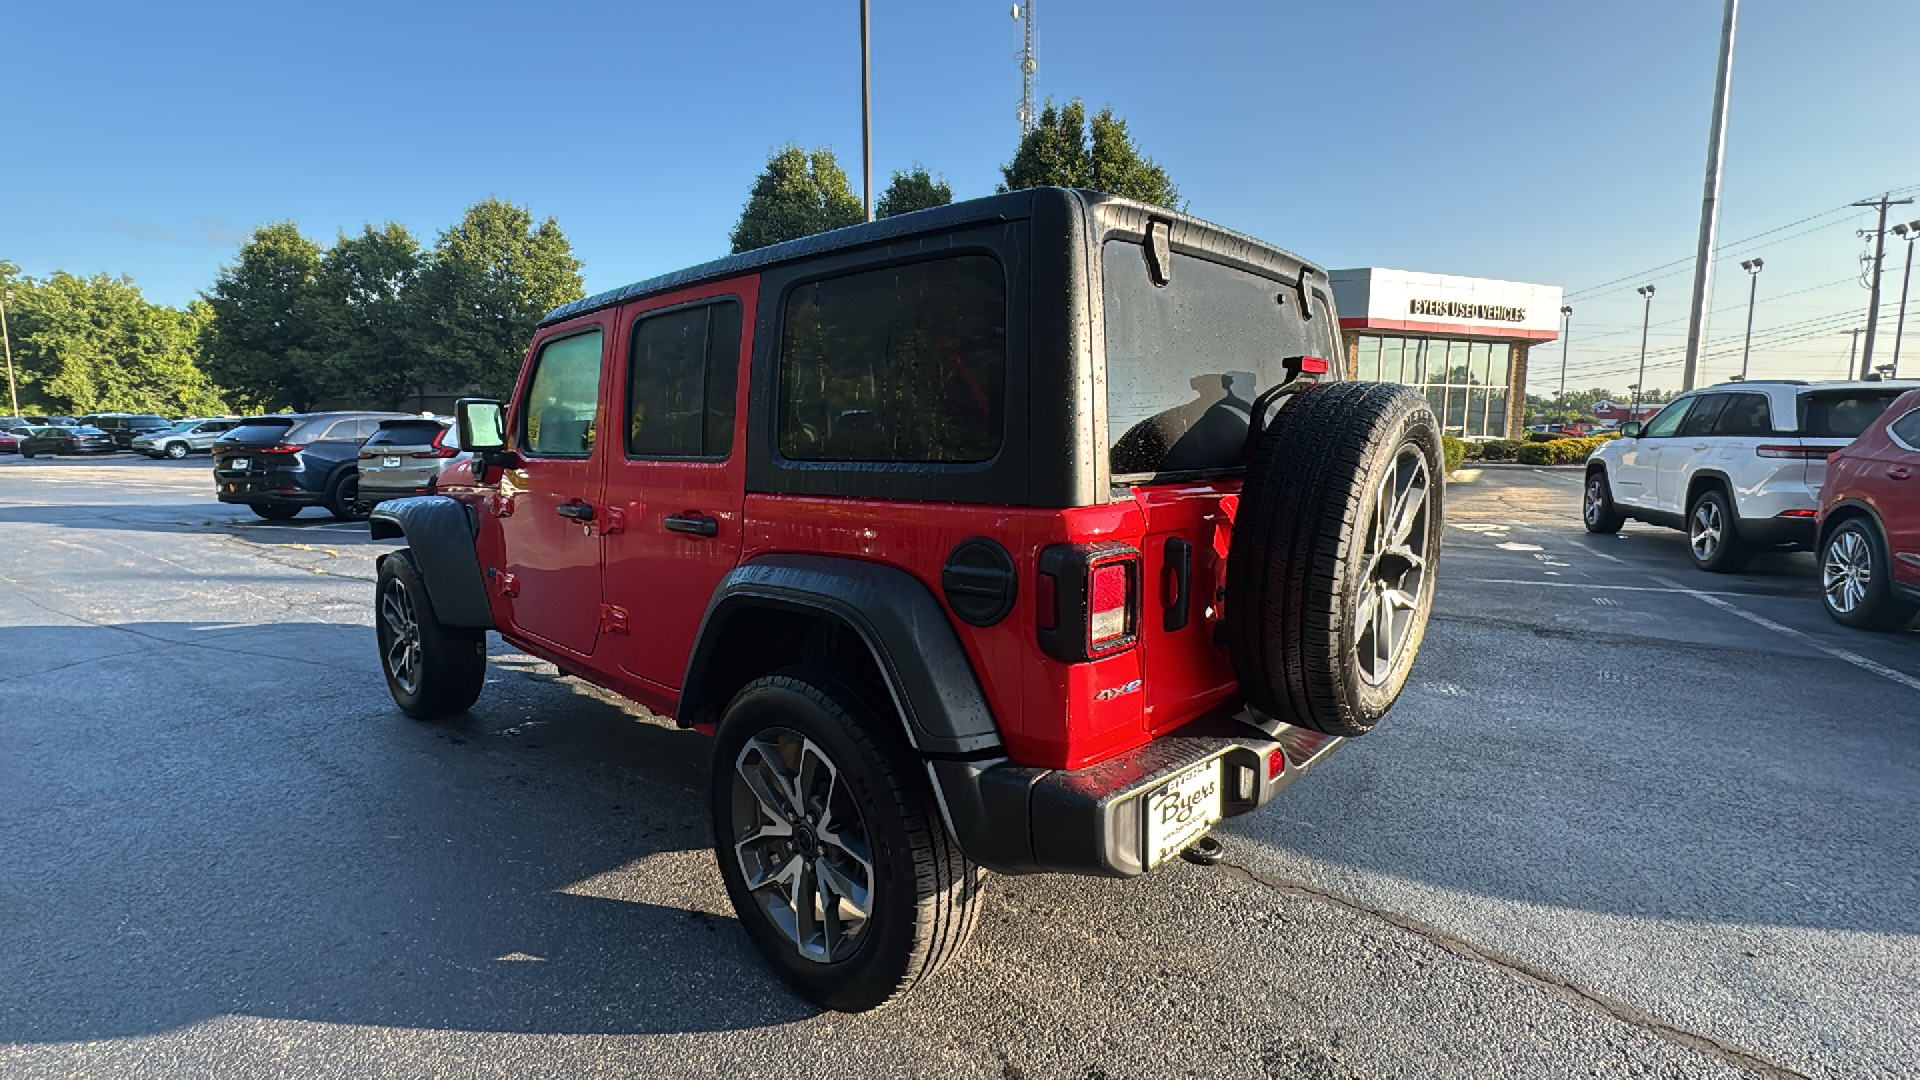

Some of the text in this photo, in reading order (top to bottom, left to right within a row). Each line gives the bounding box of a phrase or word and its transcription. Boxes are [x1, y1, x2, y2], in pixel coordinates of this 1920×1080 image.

[1411, 299, 1527, 322] BYERS USED VEHICLES
[1153, 781, 1215, 825] Byers
